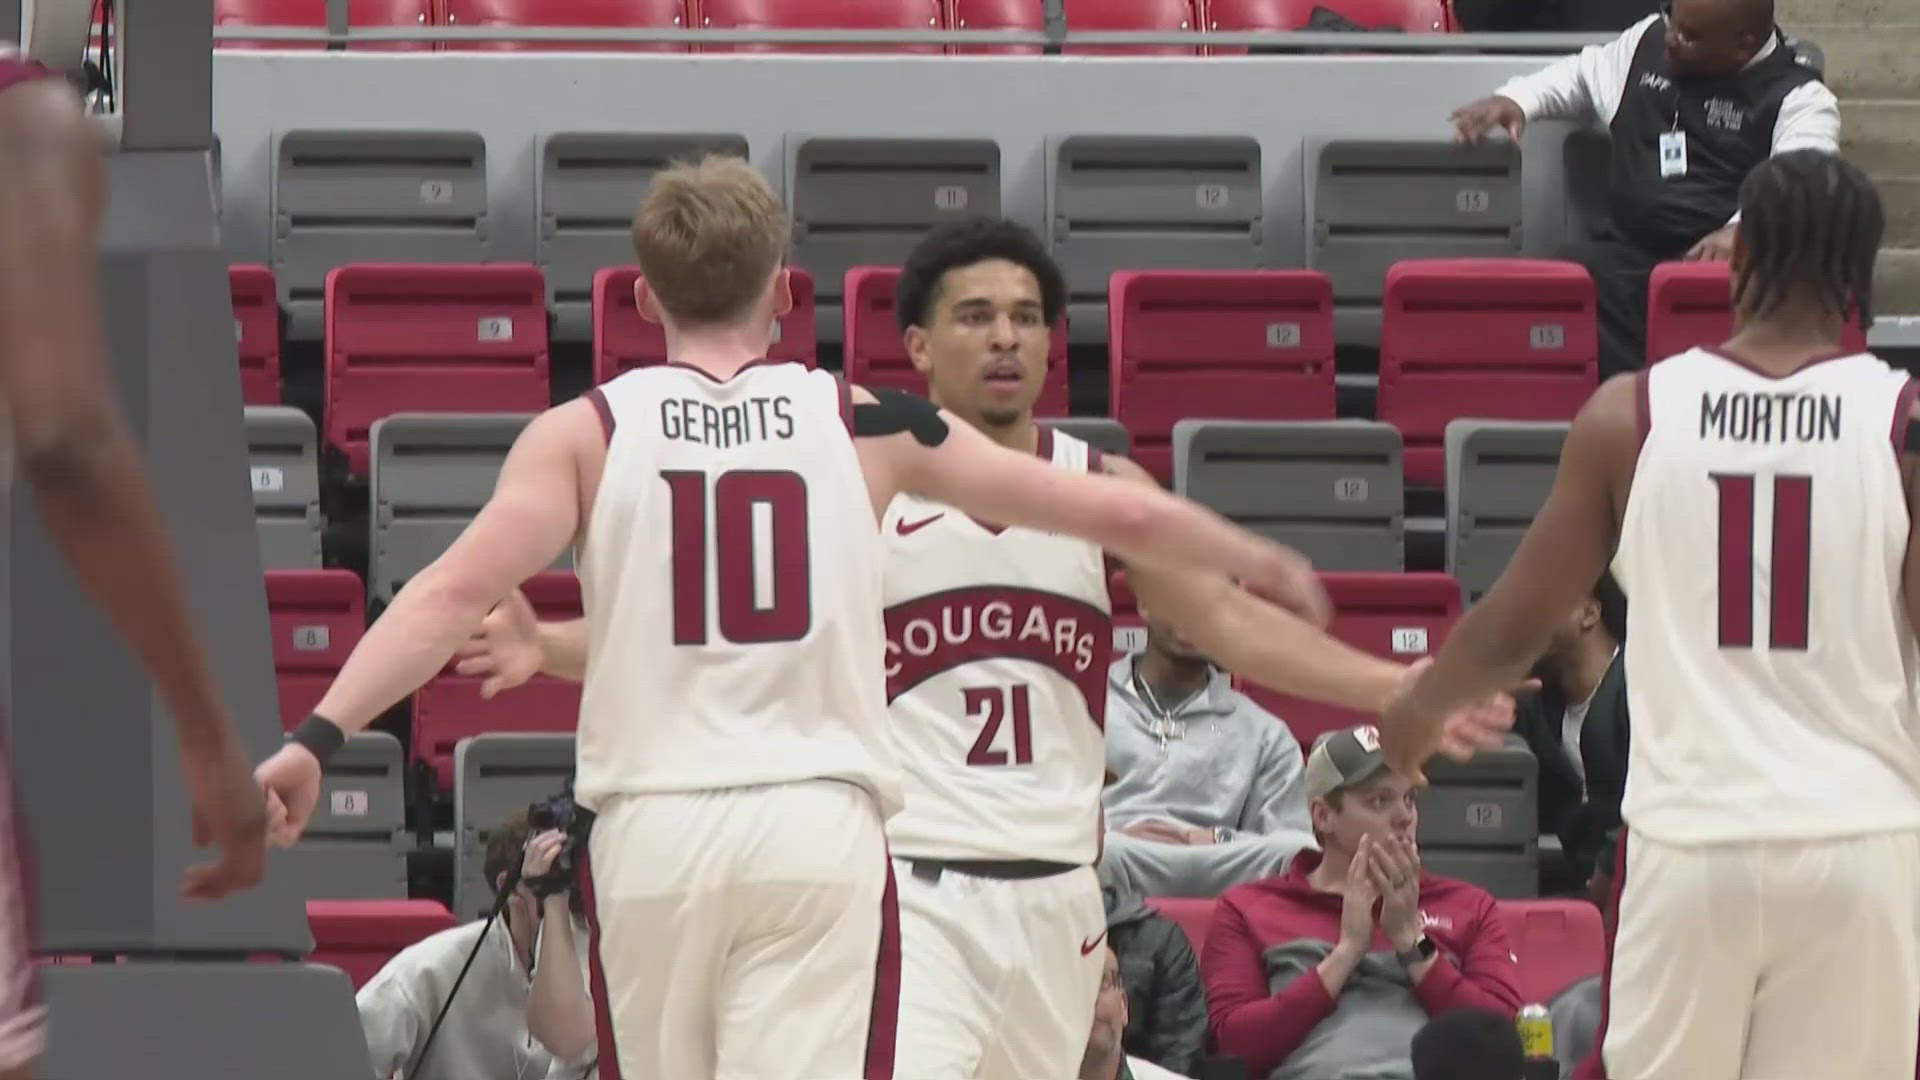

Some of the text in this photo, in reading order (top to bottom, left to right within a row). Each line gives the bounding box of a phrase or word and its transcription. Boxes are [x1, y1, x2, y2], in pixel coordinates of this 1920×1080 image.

[431, 184, 442, 200] 9
[947, 190, 957, 205] 11
[1205, 188, 1220, 204] 12
[1465, 193, 1481, 209] 13
[489, 321, 500, 337] 9
[1276, 327, 1291, 343] 12
[1539, 328, 1554, 344] 13
[660, 395, 794, 449] GERRITS
[1699, 390, 1842, 444] MORTON
[260, 470, 271, 487] 8
[1343, 481, 1359, 497] 12
[659, 469, 812, 646] 10
[1708, 470, 1813, 651] 11
[306, 630, 317, 646] 8
[1125, 631, 1136, 648] 11
[1402, 631, 1418, 649] 12
[960, 683, 1033, 767] 21
[344, 794, 355, 811] 8
[1476, 806, 1492, 823] 12
